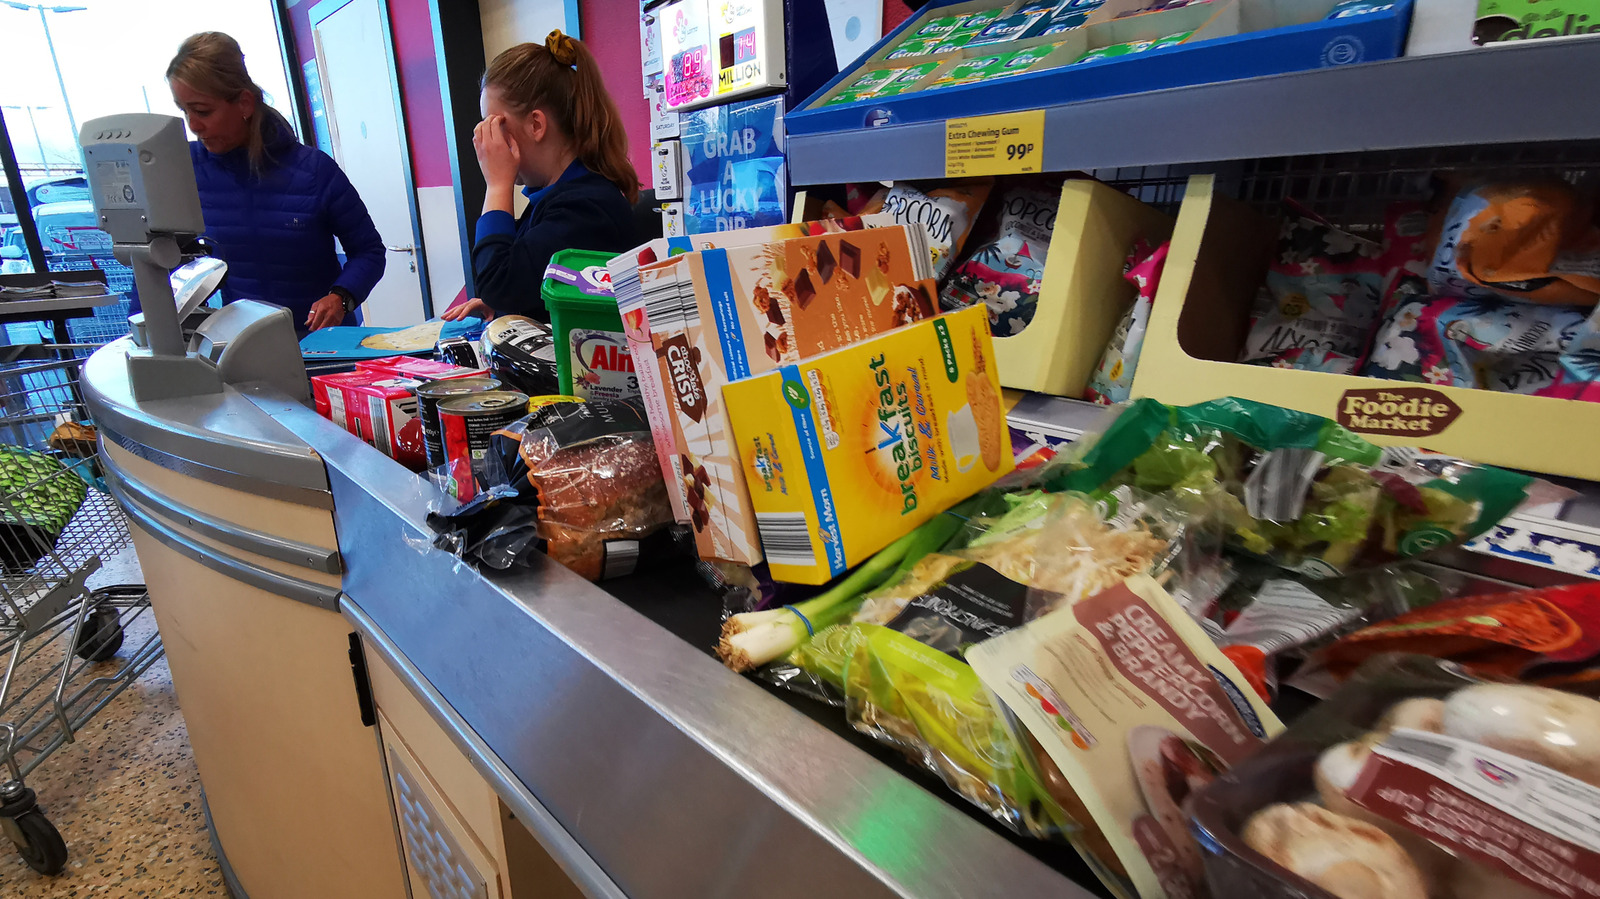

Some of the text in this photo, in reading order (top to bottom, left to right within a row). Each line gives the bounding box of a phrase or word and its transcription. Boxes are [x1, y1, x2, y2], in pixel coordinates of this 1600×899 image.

[719, 62, 761, 86] MILLION
[703, 128, 757, 159] GRAB
[948, 127, 1019, 140] Extra Chewing Gum
[722, 160, 734, 185] A
[700, 187, 763, 215] LUCKY
[715, 216, 747, 232] DIP
[590, 385, 623, 393] Lavender
[668, 345, 695, 407] CRISP
[1343, 397, 1450, 418] Foodie
[1378, 392, 1405, 401] The
[869, 352, 918, 516] breakfast
[896, 381, 923, 472] biscuits
[907, 366, 941, 481] Milk & Cereal
[1349, 415, 1433, 431] Market
[806, 437, 816, 460] Source
[820, 488, 844, 570] Harvest Morn
[1124, 604, 1211, 684] CREAMY
[1107, 613, 1247, 745] PEPPERCORN
[1111, 642, 1208, 720] BRANDY
